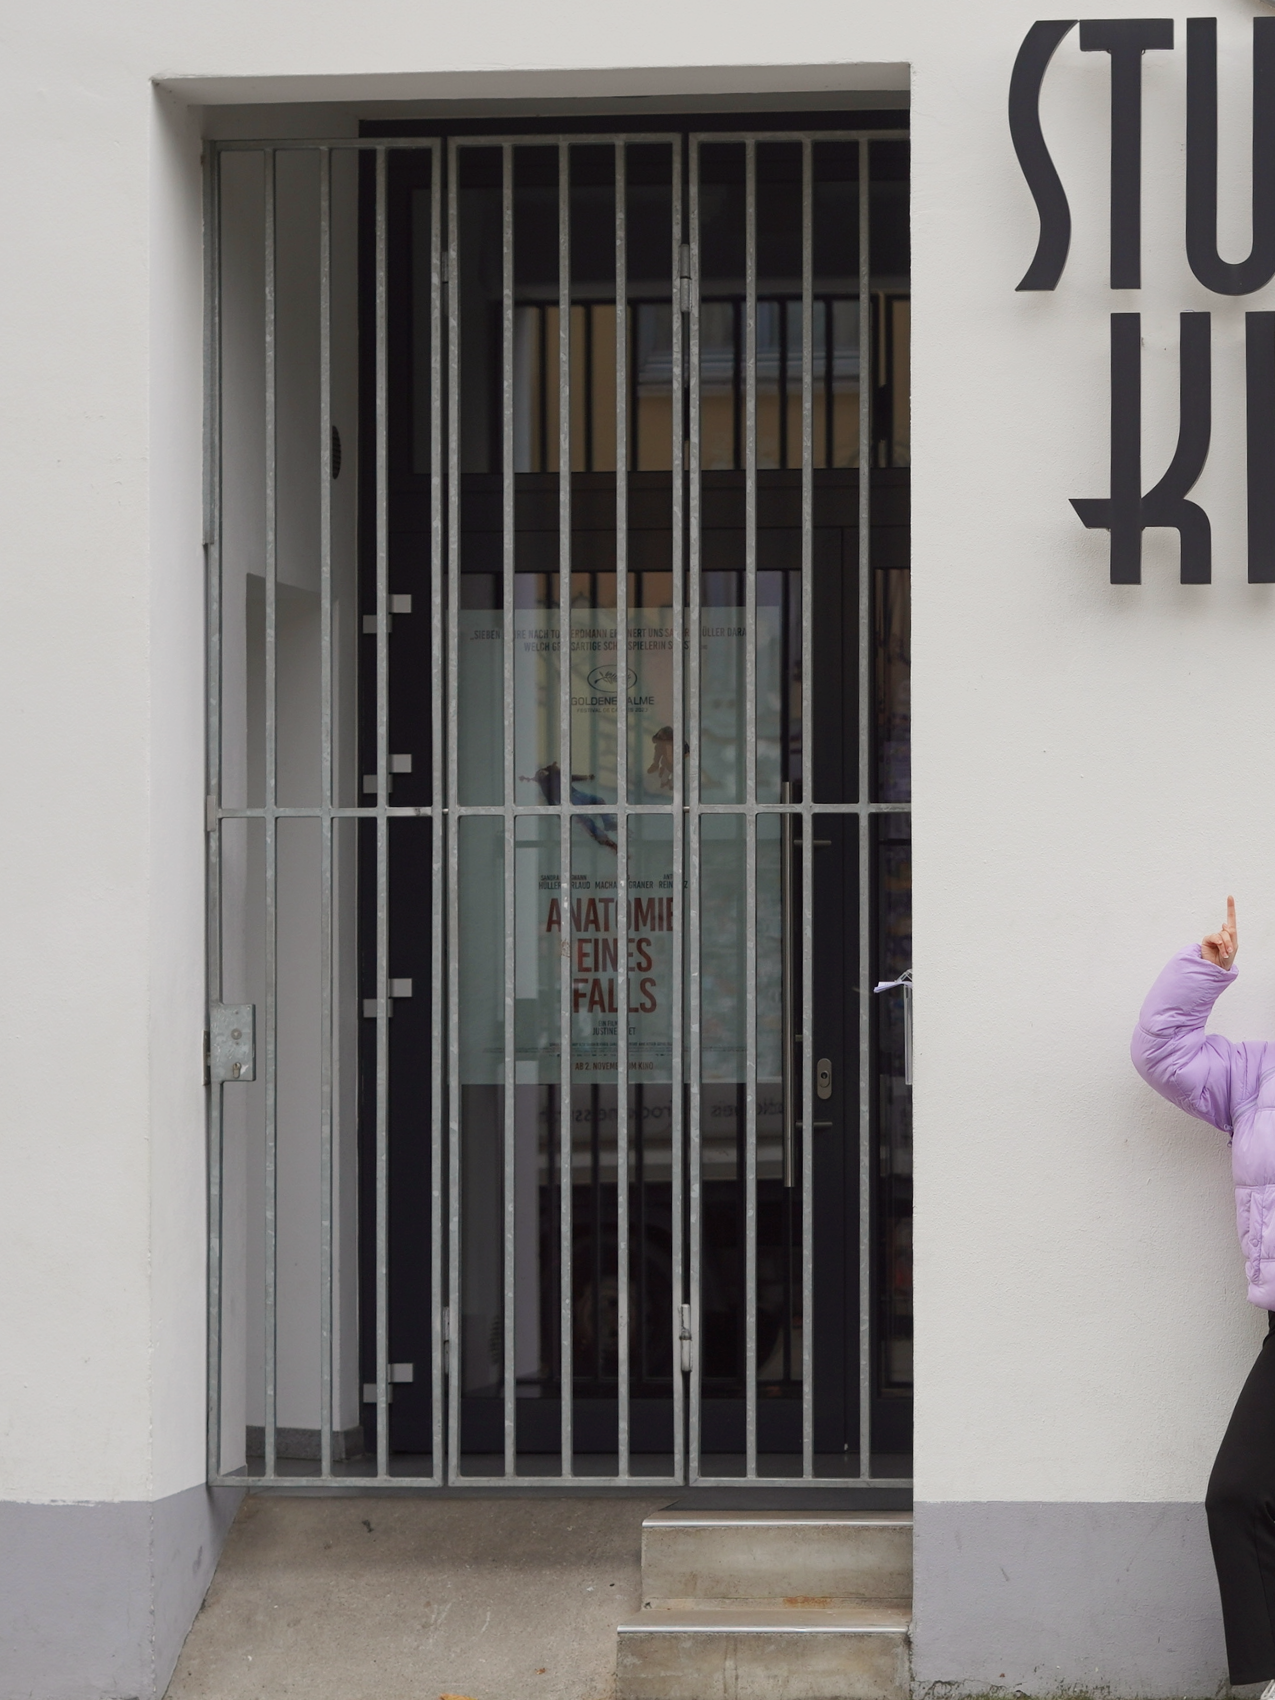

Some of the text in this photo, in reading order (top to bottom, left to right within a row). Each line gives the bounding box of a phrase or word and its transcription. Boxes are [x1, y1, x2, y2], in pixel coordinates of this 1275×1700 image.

[702, 627, 725, 638] ÜLLER
[603, 640, 666, 652] SCHSPIELERIN
[571, 696, 655, 706] GOLDENE ALME
[571, 881, 591, 890] RLAUD
[594, 881, 618, 890] MACHA
[628, 880, 654, 890] GRANER
[573, 977, 657, 1014] FALLS
